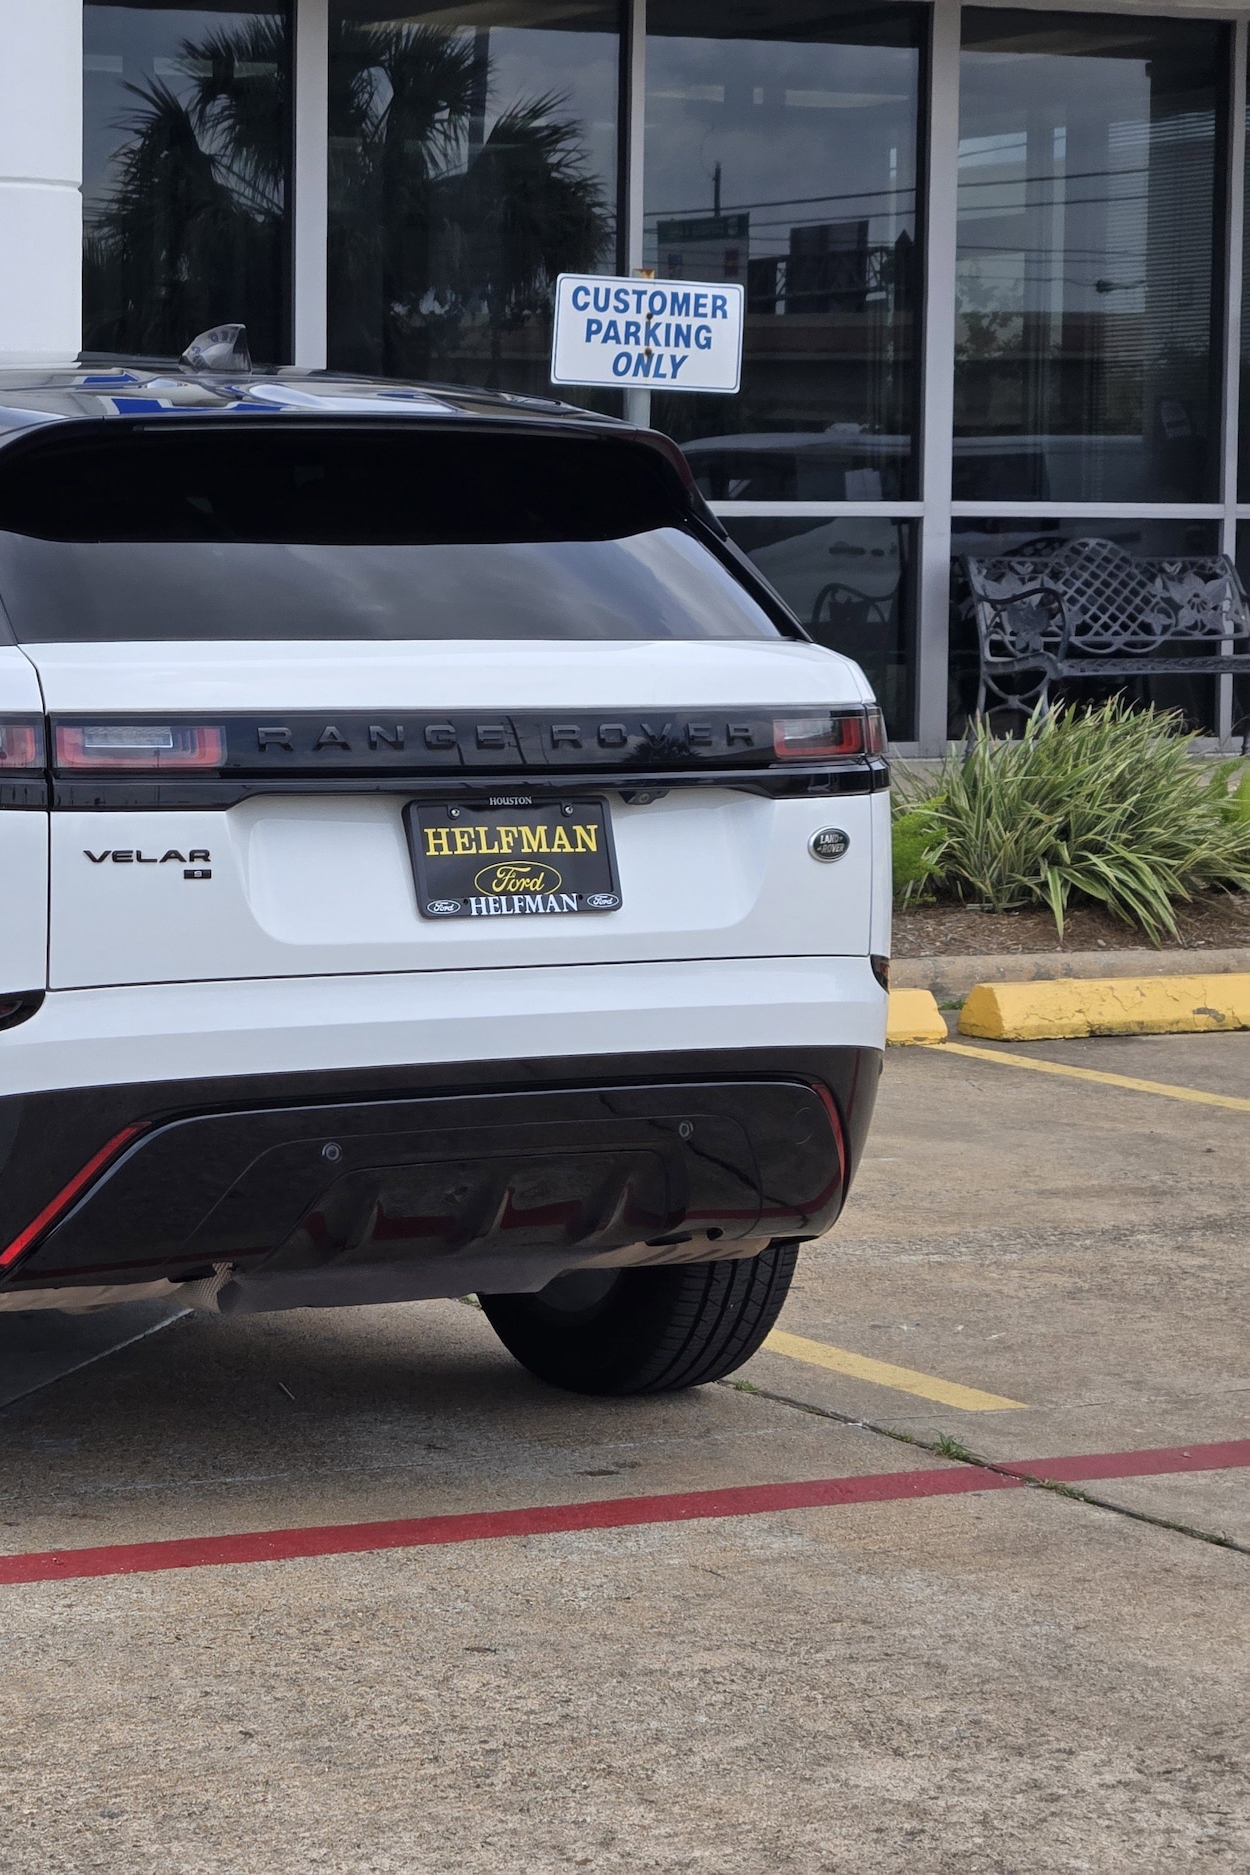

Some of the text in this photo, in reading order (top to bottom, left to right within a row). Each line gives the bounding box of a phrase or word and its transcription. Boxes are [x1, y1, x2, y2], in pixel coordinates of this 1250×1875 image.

[571, 285, 728, 319] CUSTOMER
[585, 318, 713, 350] PARKING
[612, 351, 689, 379] ONLY
[256, 722, 756, 753] RANGE ROVER
[489, 796, 533, 806] HOUSTON
[423, 824, 599, 856] HELFMAN
[820, 834, 839, 845] LAND
[820, 843, 845, 854] ROVER
[83, 849, 212, 863] VELAR
[491, 866, 546, 893] Ford
[433, 892, 614, 917] Ford HELFMAN Ford
